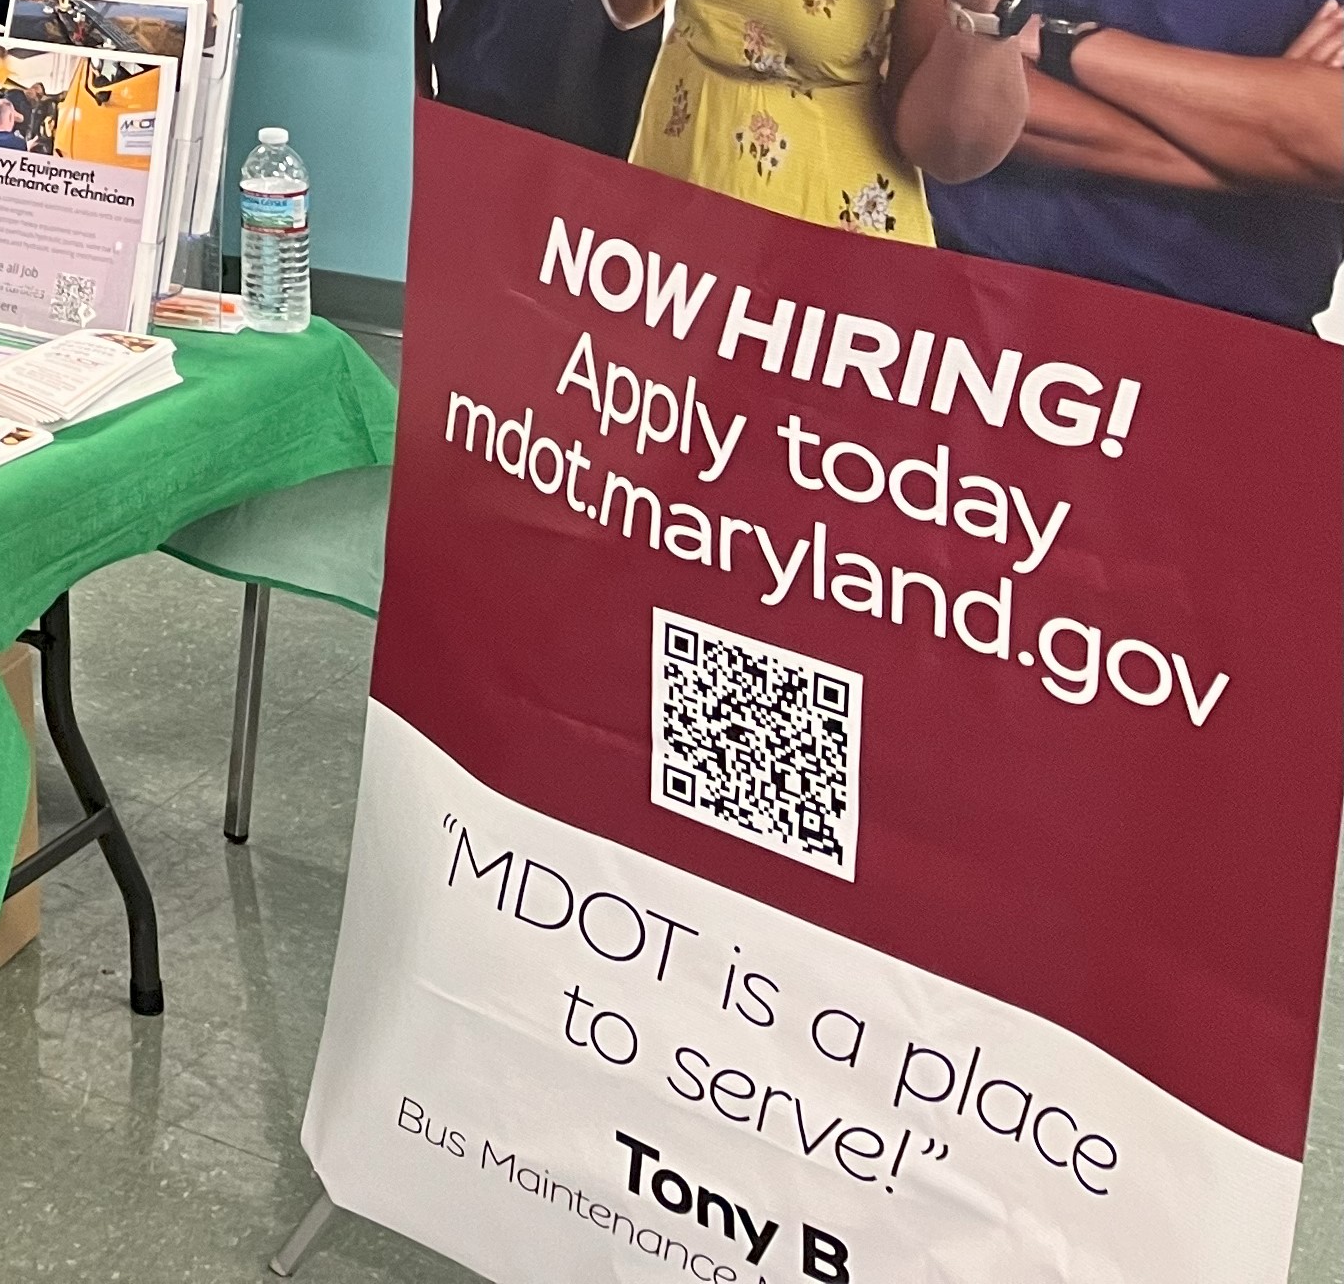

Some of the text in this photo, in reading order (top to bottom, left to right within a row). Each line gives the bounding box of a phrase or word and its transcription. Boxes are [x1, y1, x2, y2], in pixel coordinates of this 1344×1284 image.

[19, 157, 96, 184] Equipment
[63, 181, 135, 208] Technician
[539, 216, 1142, 459] NOW HIRING!
[555, 331, 1072, 574] Apply today
[444, 388, 1232, 729] mdot.maryland.gov
[562, 983, 639, 1067] to
[721, 945, 781, 1028] is
[811, 1007, 866, 1067] a
[892, 1042, 1119, 1197] place
[396, 1096, 739, 1284] Bus Maintenance
[614, 1130, 850, 1284] Tony B
